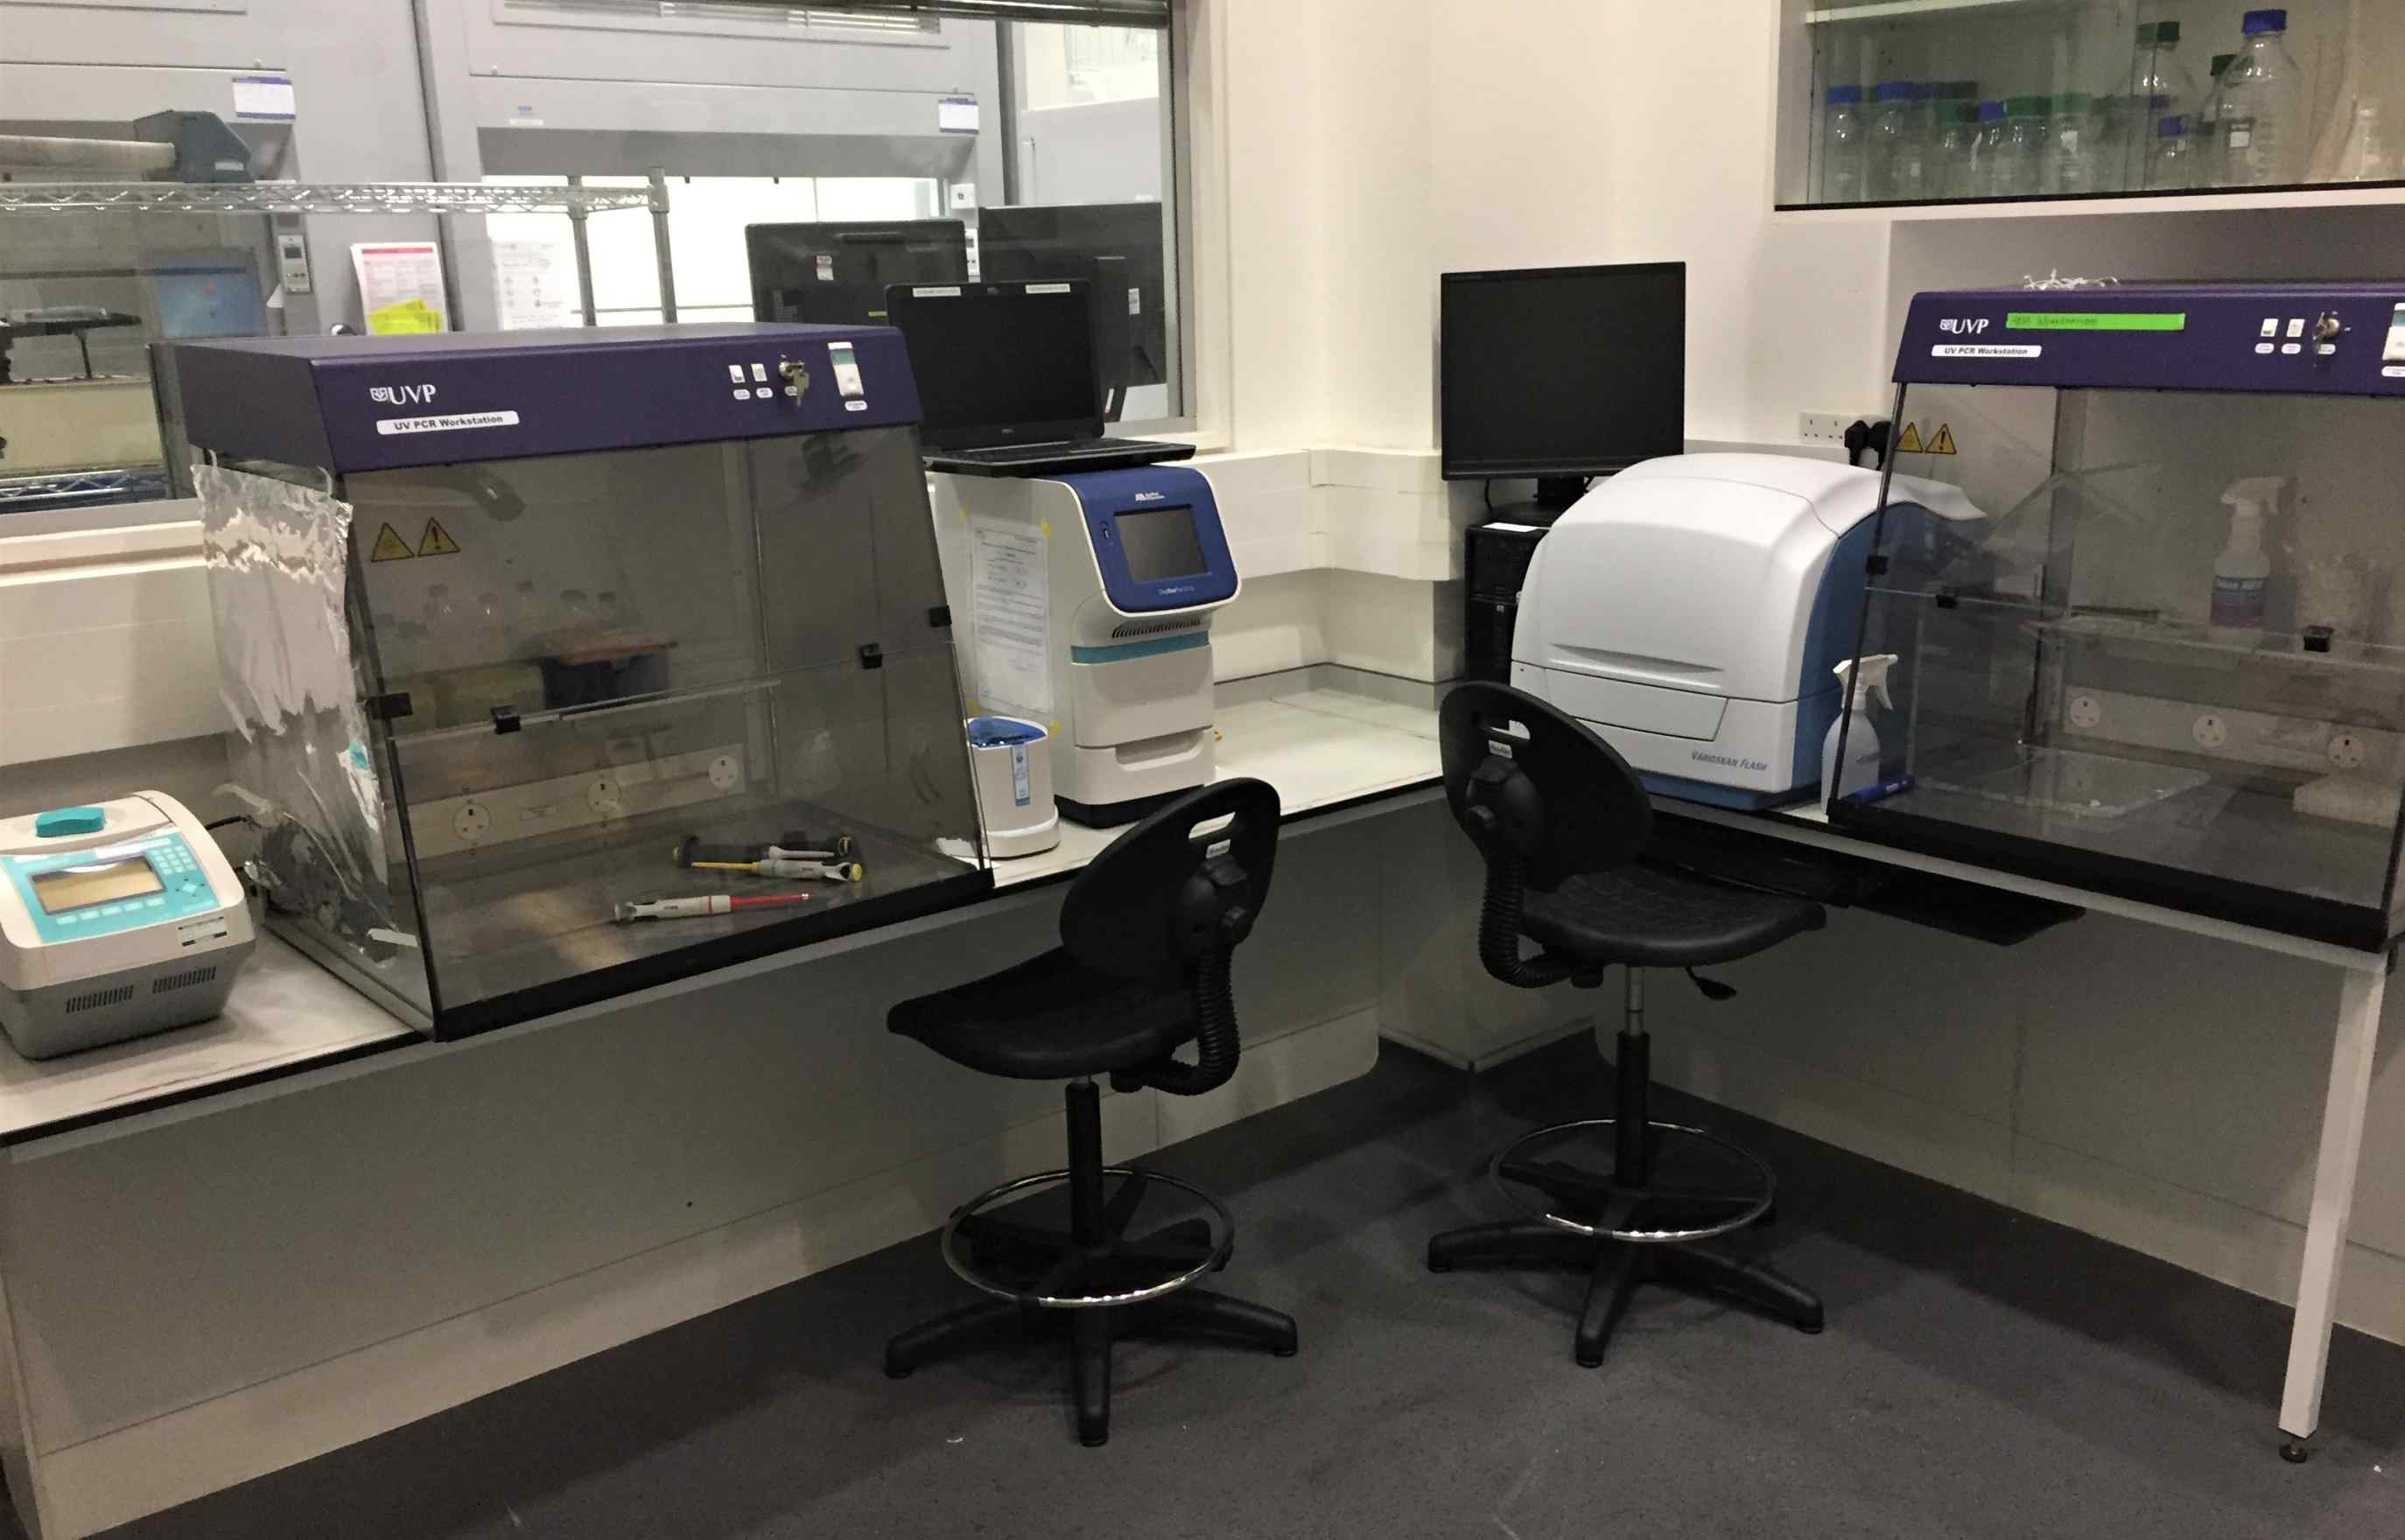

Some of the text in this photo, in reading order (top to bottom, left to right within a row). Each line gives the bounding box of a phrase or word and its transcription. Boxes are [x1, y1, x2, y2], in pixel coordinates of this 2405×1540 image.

[1952, 318, 1989, 334] UVP
[388, 383, 437, 405] UVP
[394, 415, 504, 430] UV PCR Workstation
